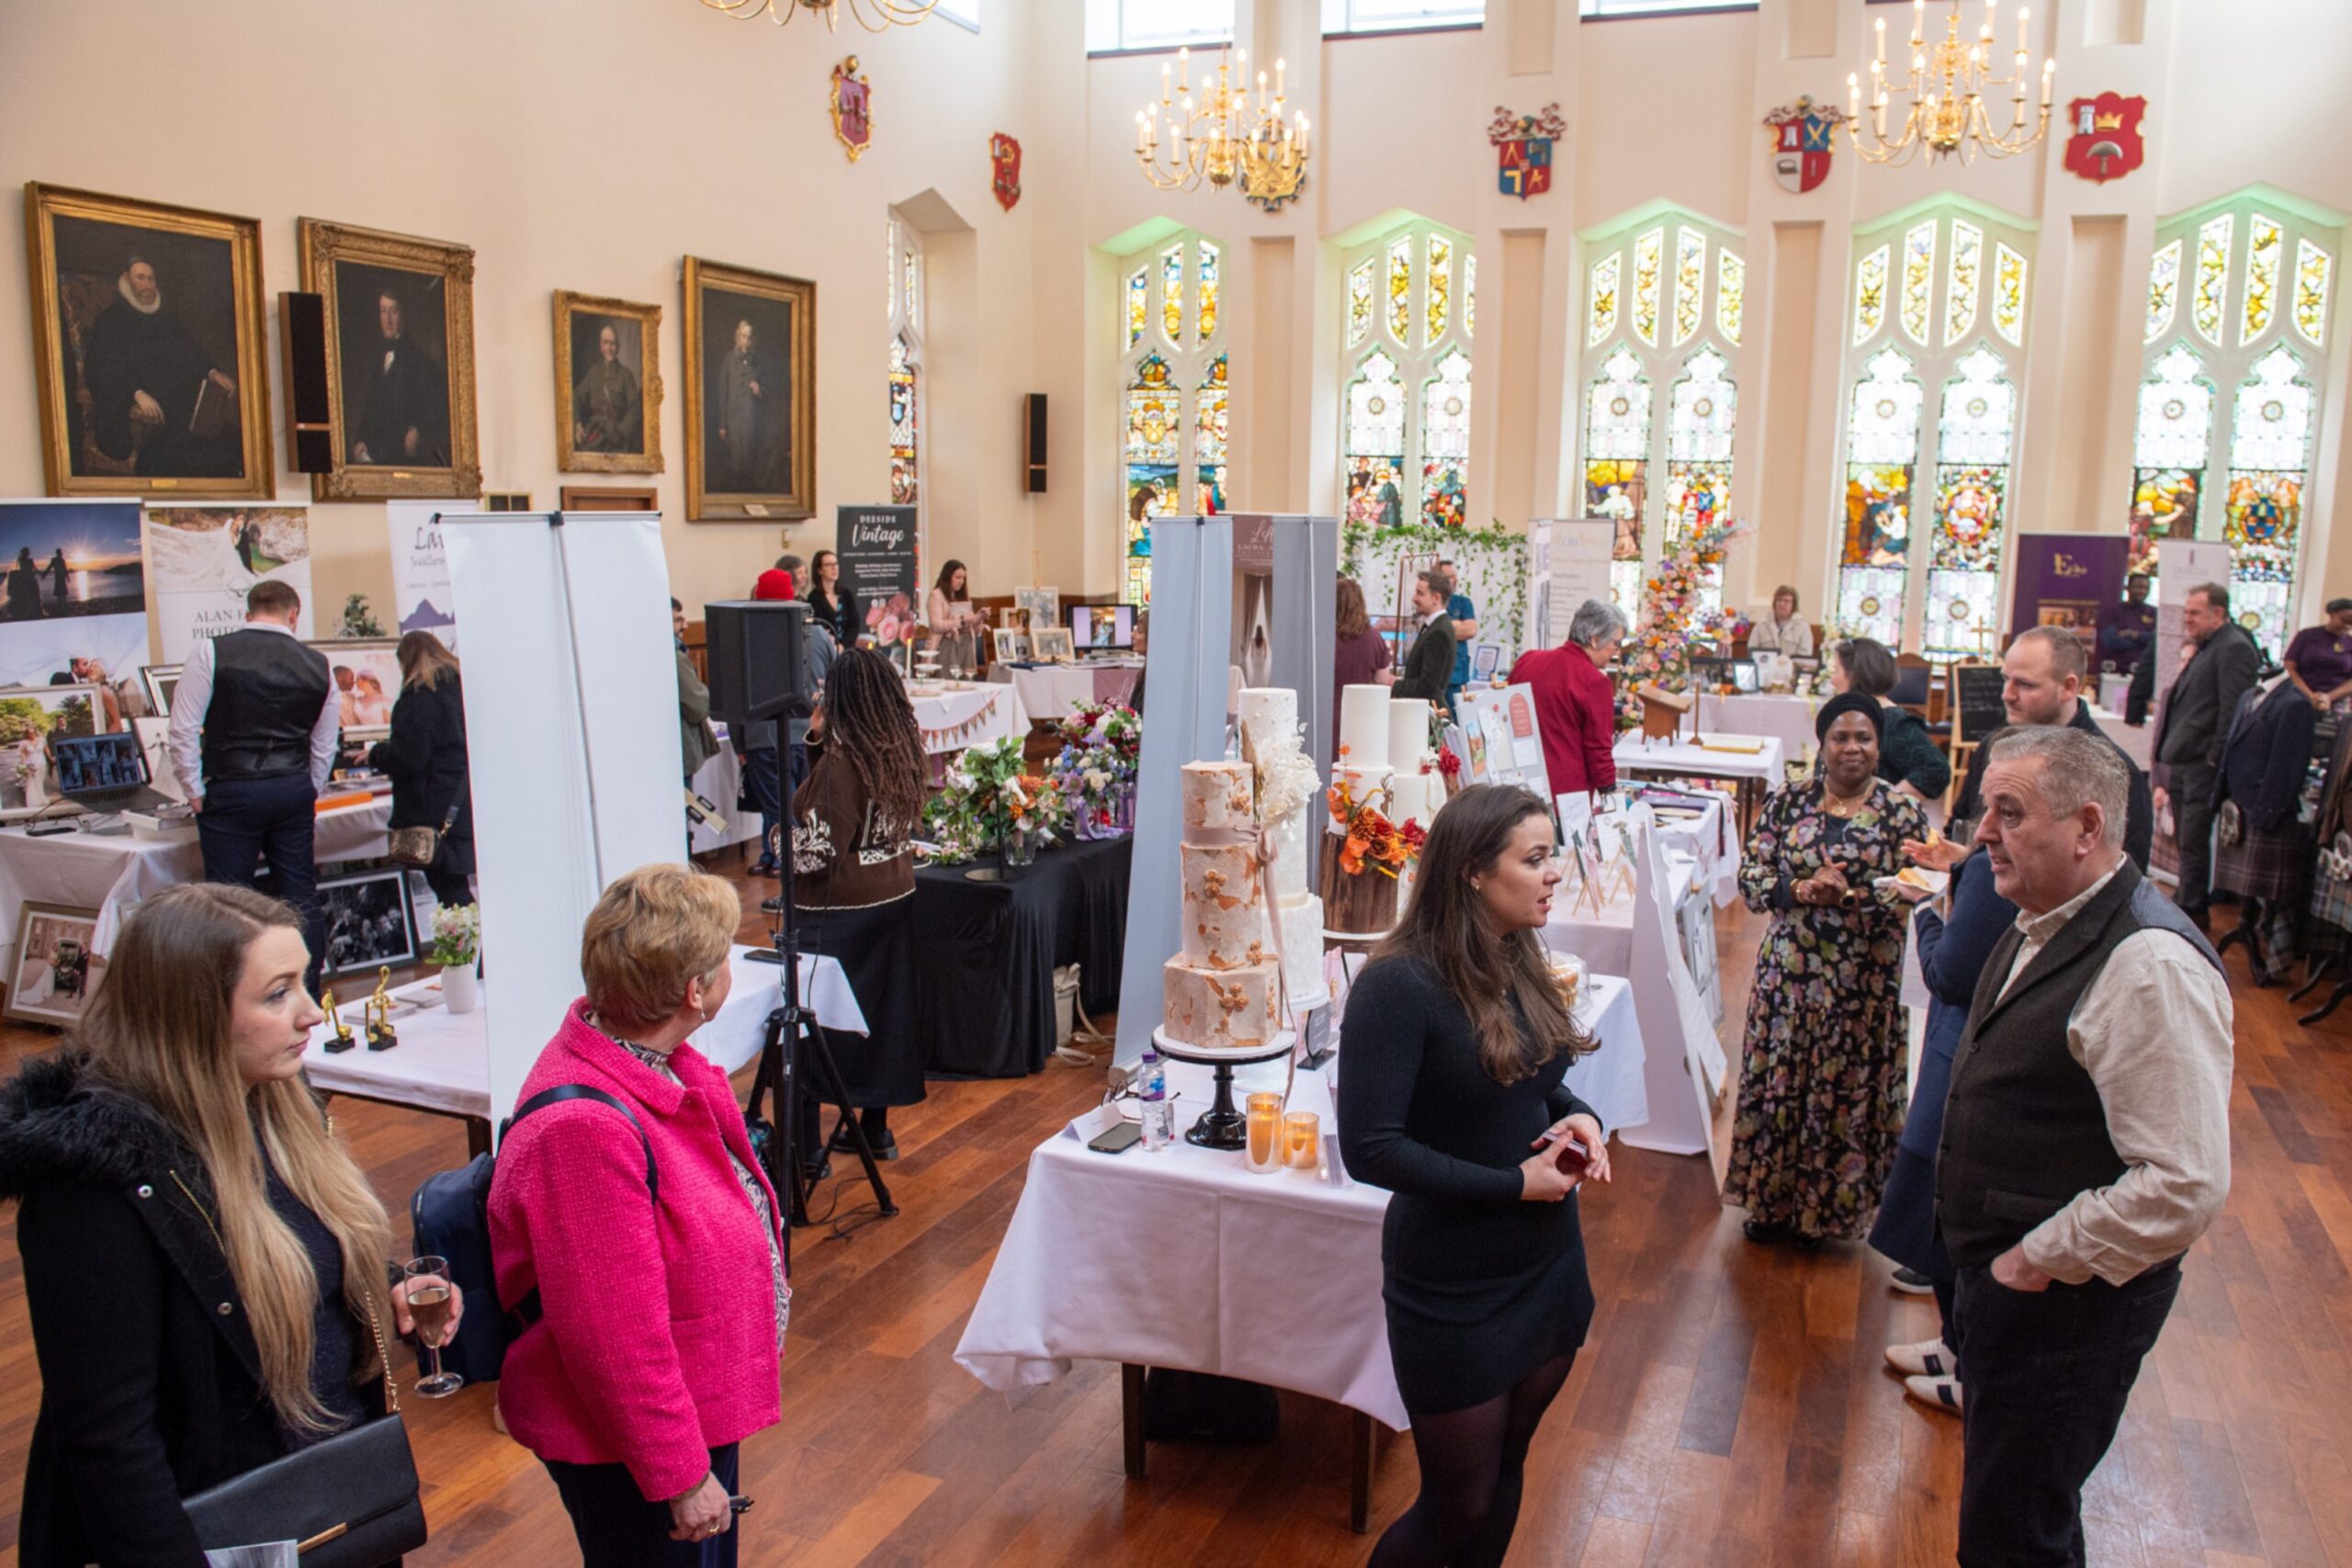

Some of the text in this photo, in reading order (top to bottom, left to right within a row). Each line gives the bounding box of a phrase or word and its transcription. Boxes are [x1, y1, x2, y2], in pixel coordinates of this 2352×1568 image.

[860, 515, 896, 524] DEESIDE
[852, 524, 904, 549] Vintage
[195, 609, 232, 623] ALAN
